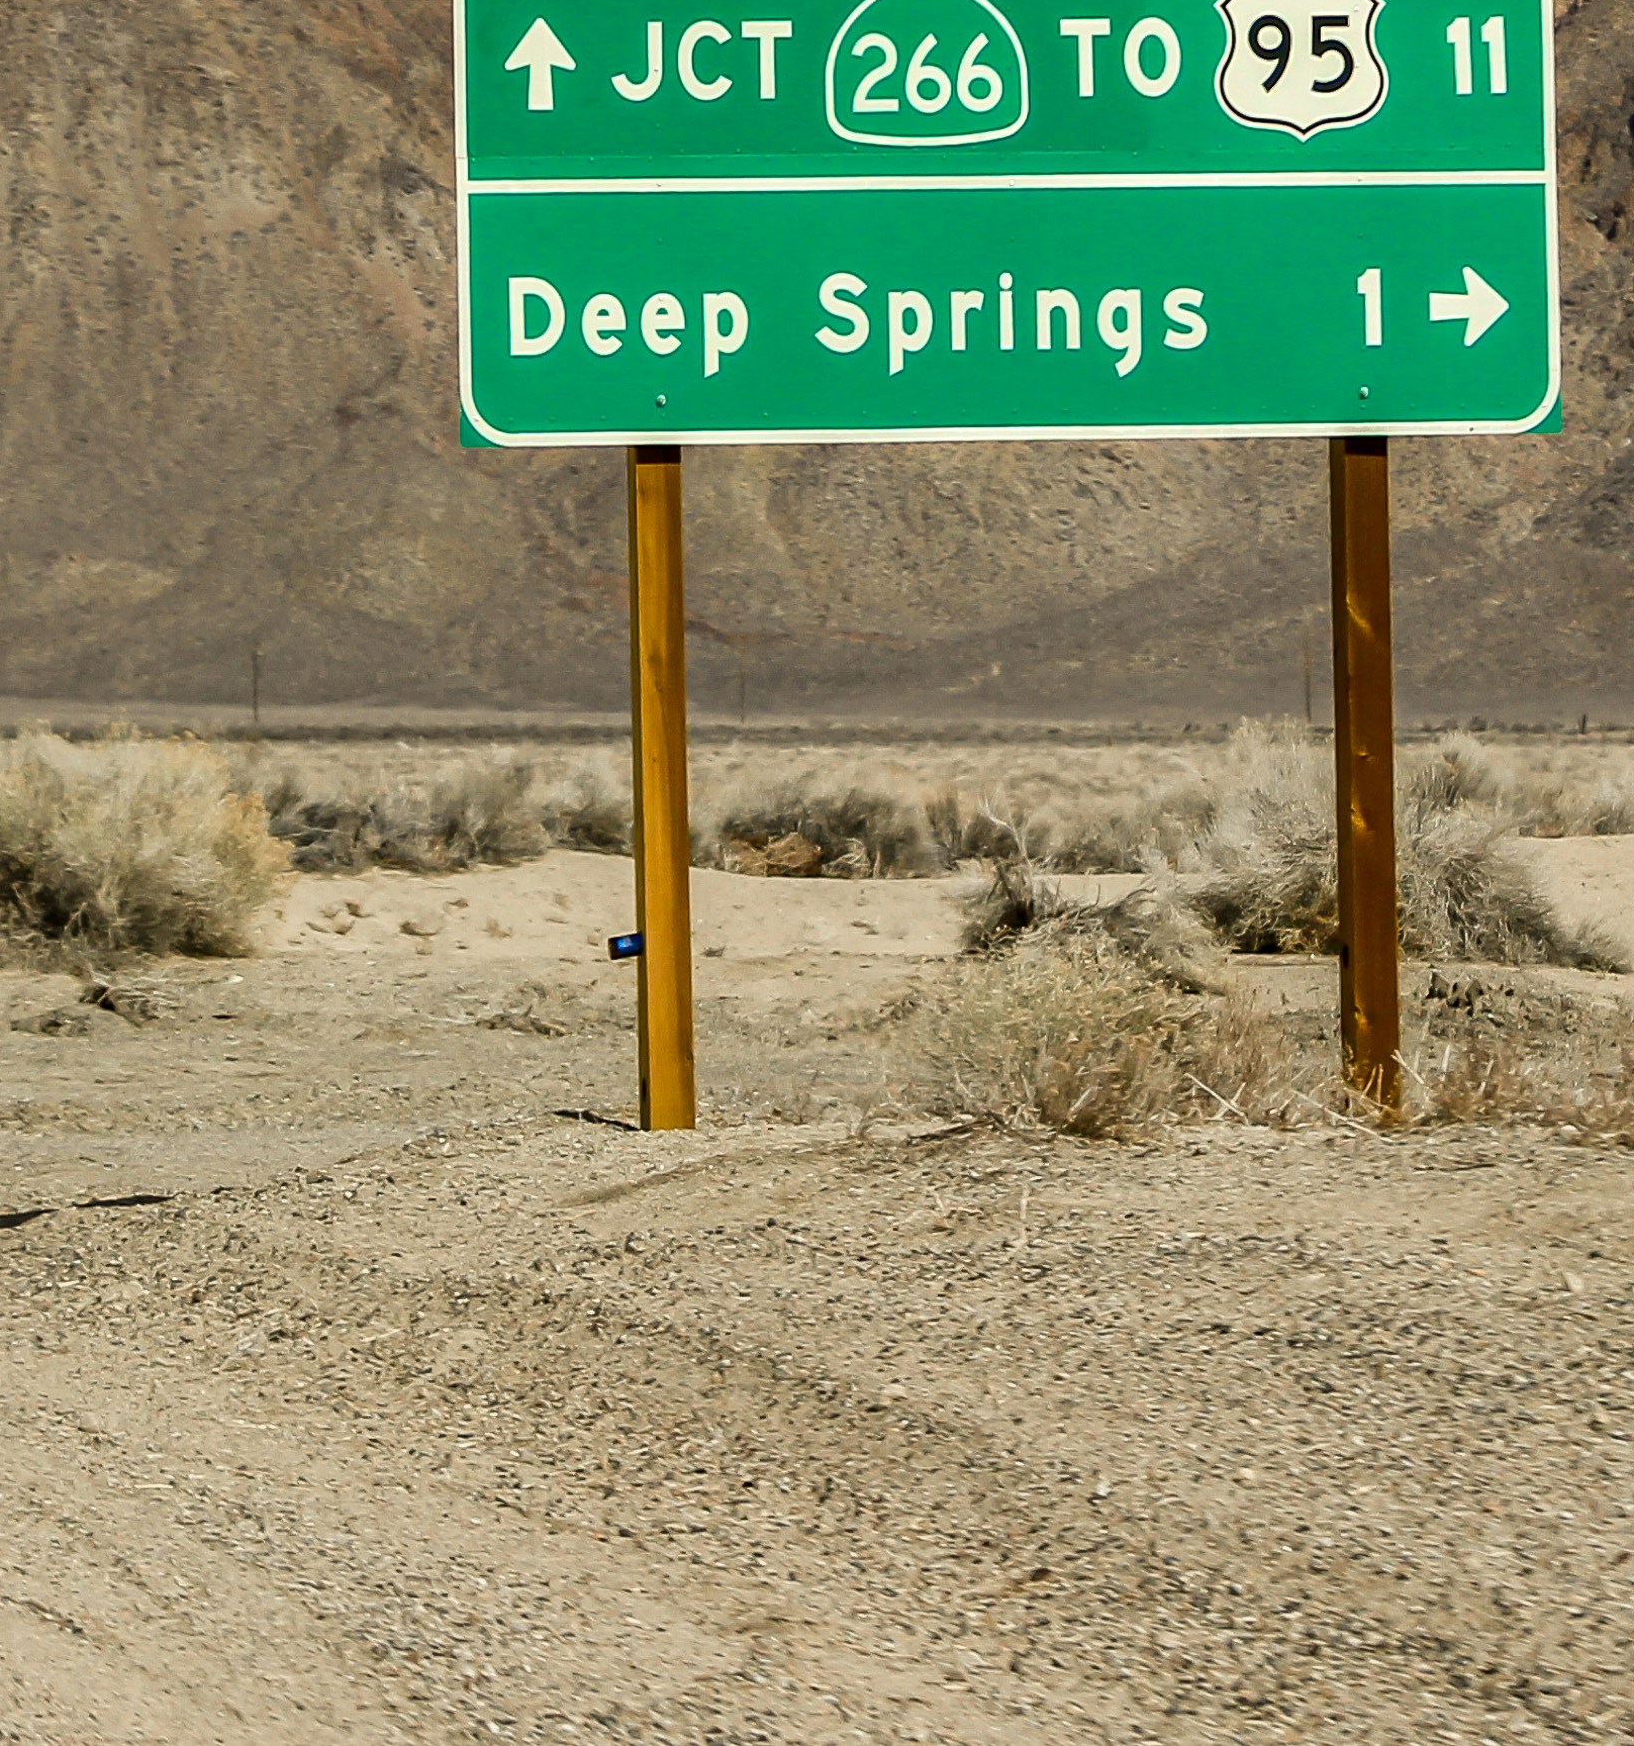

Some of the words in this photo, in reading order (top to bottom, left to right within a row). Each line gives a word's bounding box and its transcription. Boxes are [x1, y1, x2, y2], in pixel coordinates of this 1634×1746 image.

[612, 21, 792, 101] JCT
[852, 33, 1002, 113] 266
[1060, 17, 1181, 96] TO
[1248, 15, 1353, 93] 95
[1447, 16, 1506, 94] 11
[509, 277, 748, 376] Deep
[815, 273, 1207, 376] Springs
[1358, 269, 1381, 345] 1
